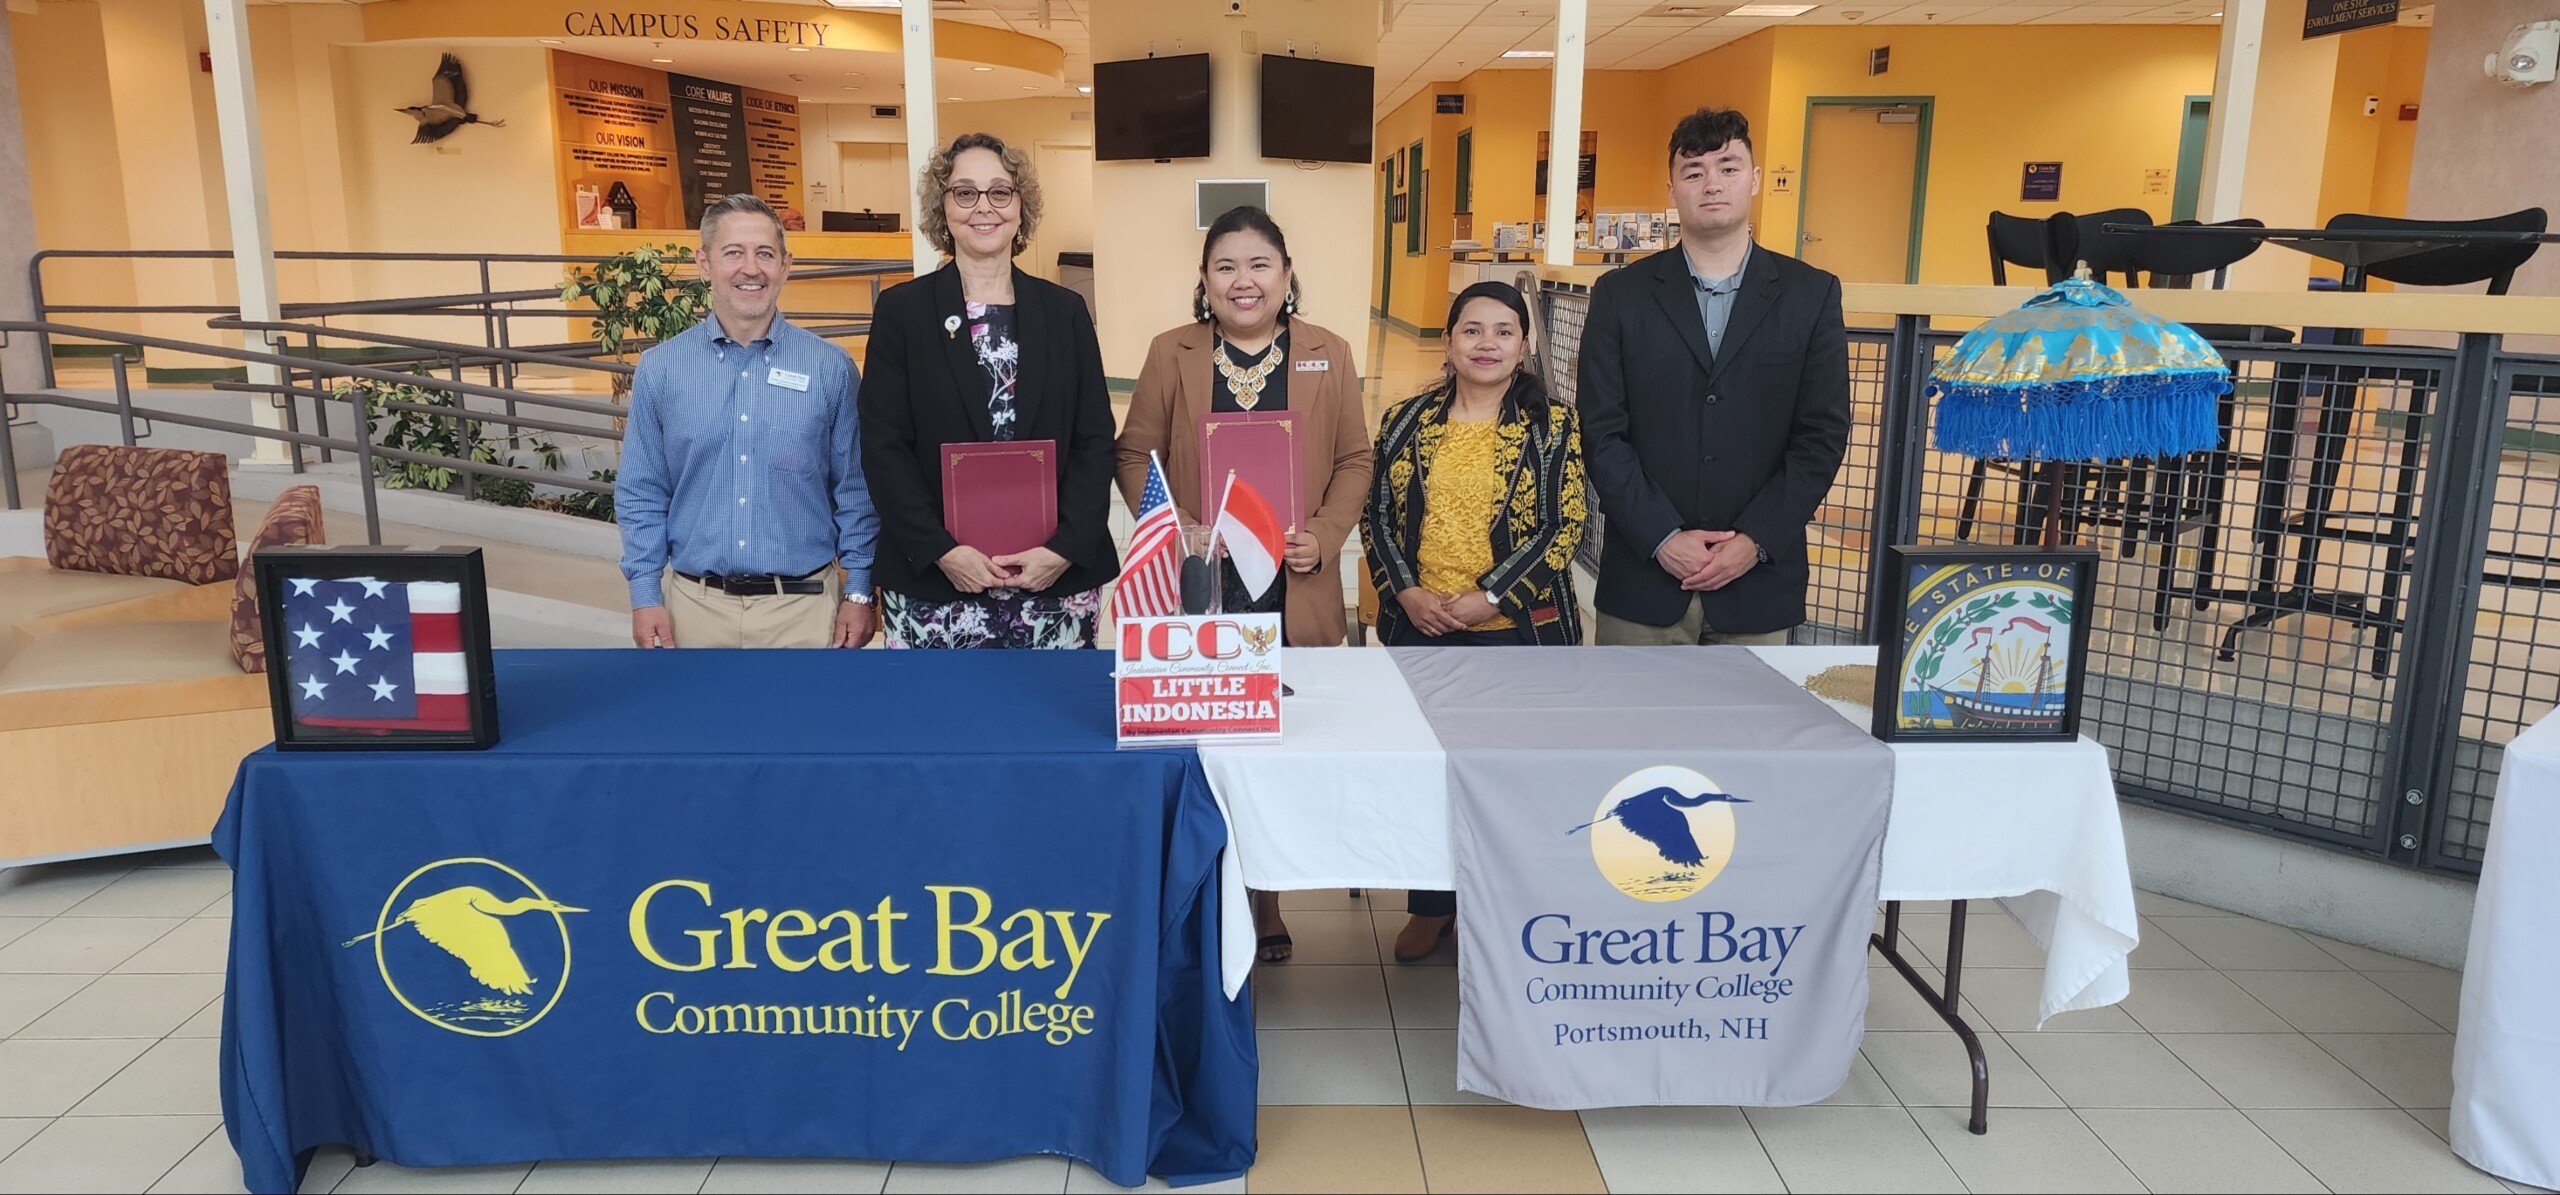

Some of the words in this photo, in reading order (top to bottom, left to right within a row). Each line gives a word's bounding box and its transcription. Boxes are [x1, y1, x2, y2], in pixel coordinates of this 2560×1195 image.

[2306, 10, 2357, 29] ENROLLMENT
[2358, 2, 2396, 19] SERVICES
[2333, 1, 2349, 12] ONE
[2350, 0, 2369, 10] STOP
[565, 11, 699, 39] CAMPUS
[715, 16, 830, 46] SAFETY
[589, 79, 609, 93] OUR
[610, 83, 644, 98] MISSION
[685, 85, 705, 99] CORE
[706, 89, 733, 103] VALUES
[746, 96, 764, 109] CODE
[765, 100, 773, 110] OF
[774, 102, 795, 113] ETHICS
[596, 132, 615, 145] OUR
[617, 134, 644, 148] VISION
[1931, 562, 2013, 605] STATE
[2038, 563, 2071, 581] OF
[1122, 620, 1242, 662] ICC
[1120, 663, 1168, 676] Indonesian
[1169, 663, 1214, 674] Community
[1217, 662, 1249, 672] Connect
[1250, 661, 1273, 672] Inc.
[1152, 677, 1246, 698] LITTLE
[1121, 700, 1276, 723] INDONESIA
[628, 879, 911, 975] Great
[924, 884, 1111, 999] Bay
[1521, 913, 1684, 965] Great
[1694, 911, 1806, 976] Bay
[1526, 976, 1691, 1007] Community
[1696, 973, 1793, 1004] College
[635, 991, 923, 1051] Community
[932, 989, 1095, 1046] College
[1554, 1018, 1711, 1046] Portsmouth,
[1720, 1017, 1769, 1041] NH
